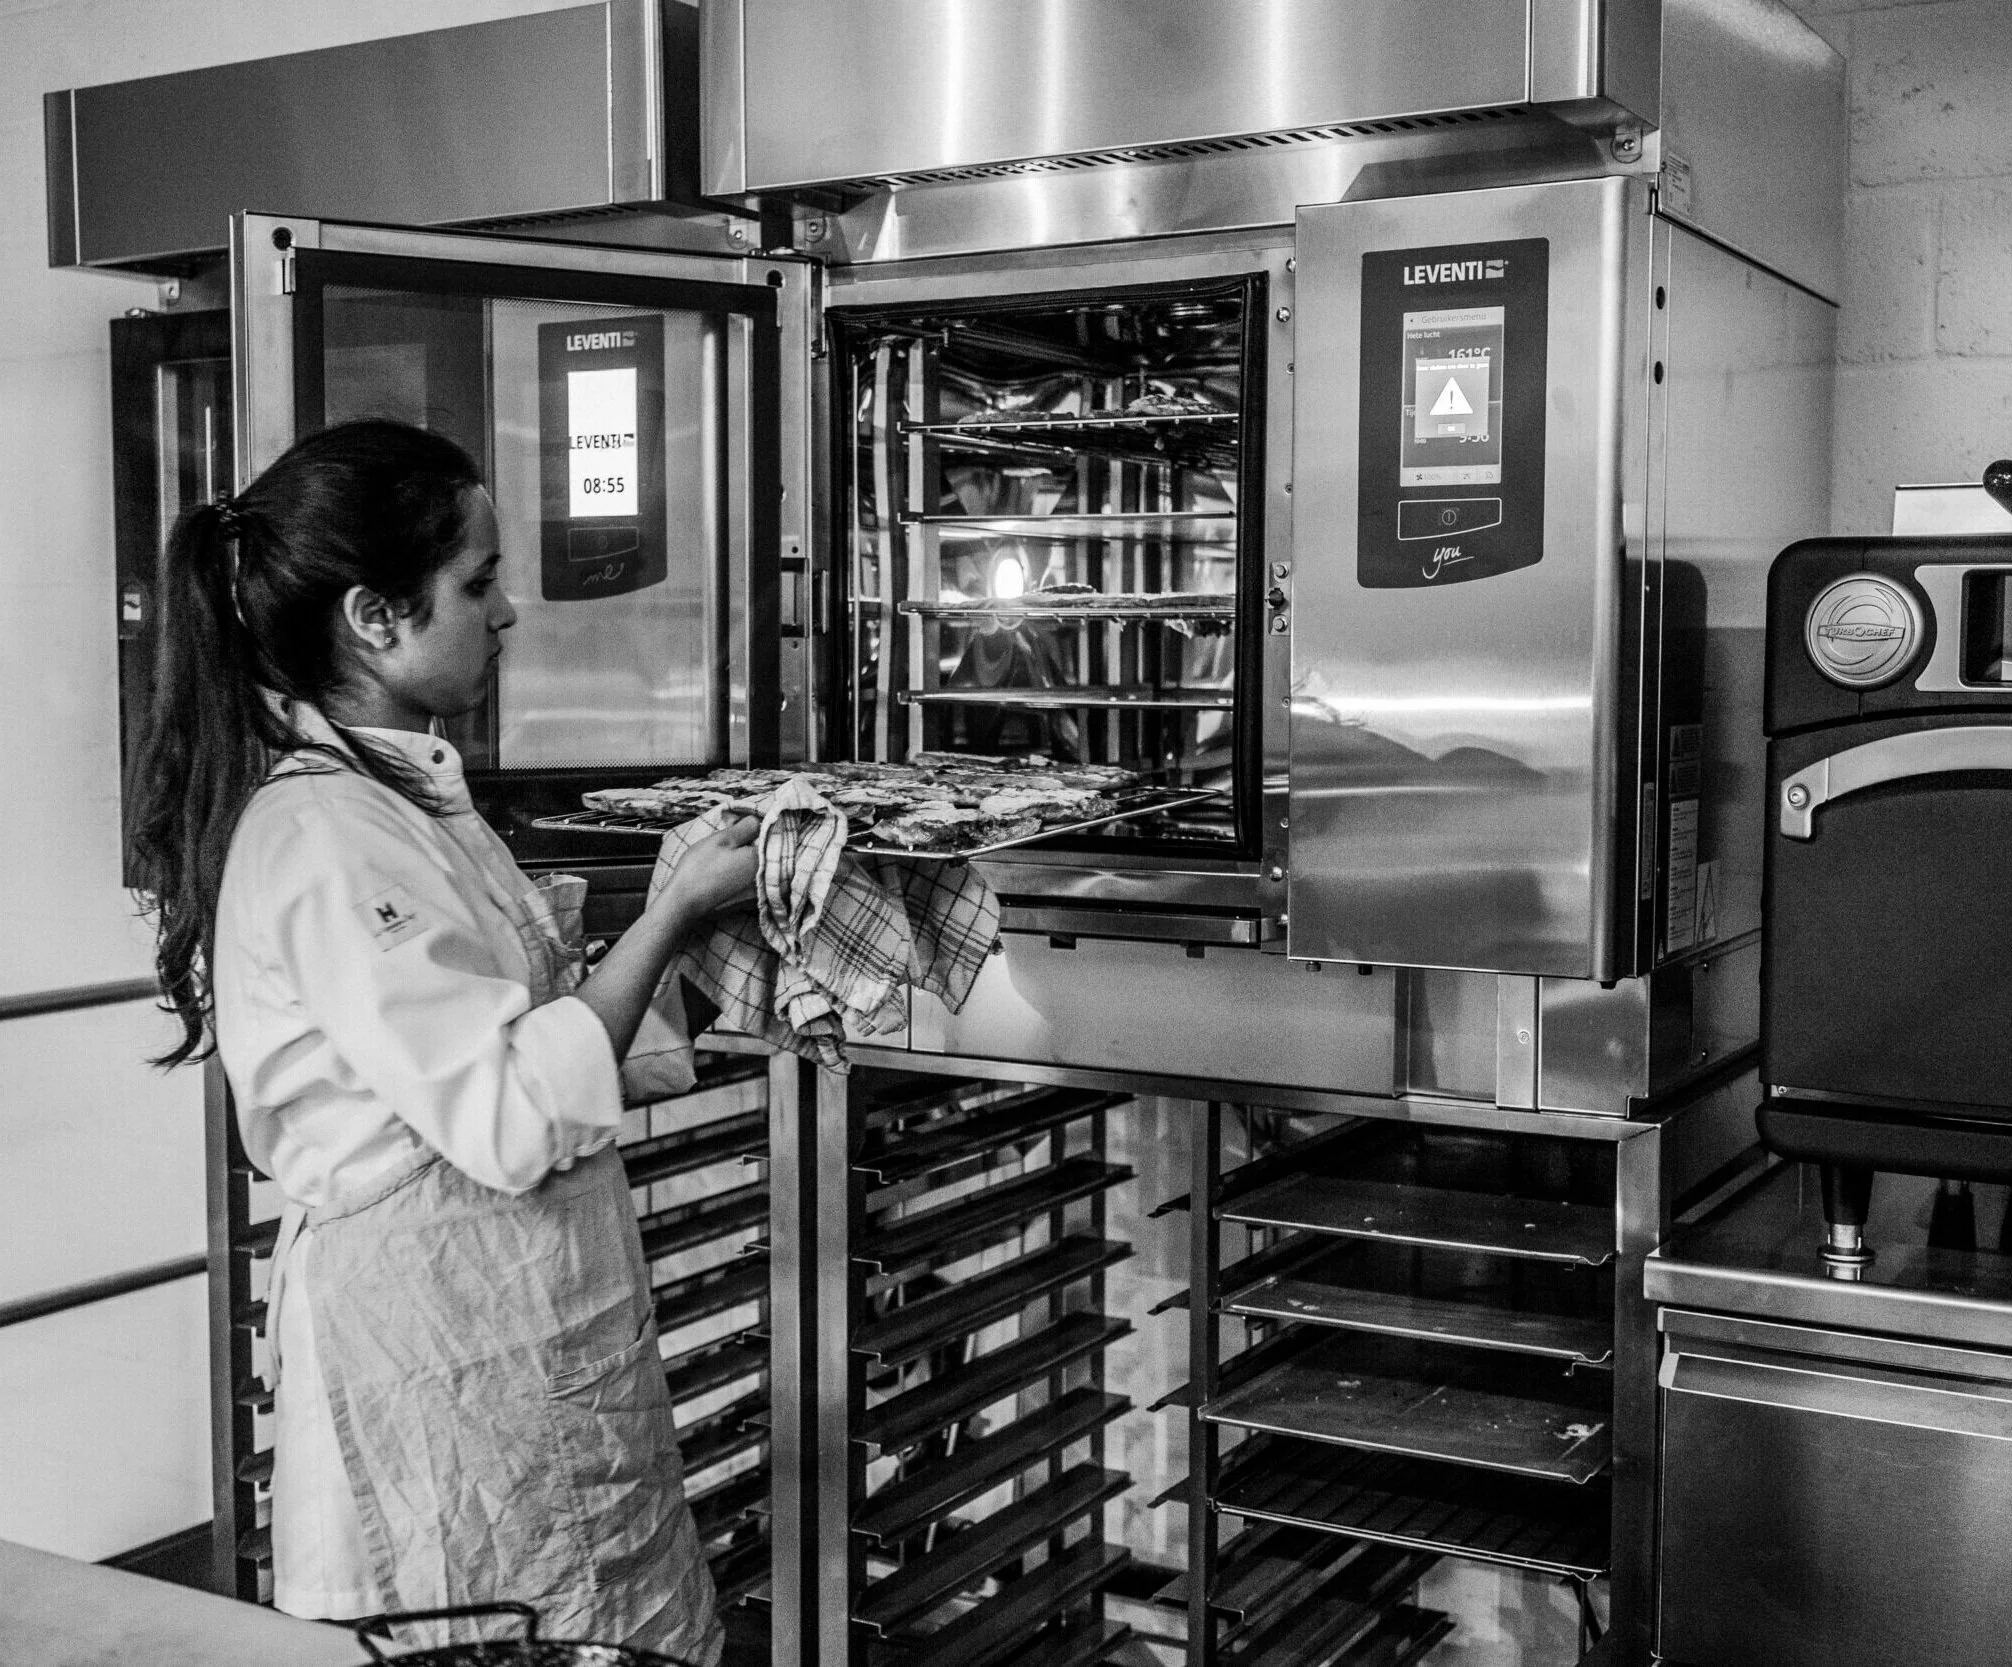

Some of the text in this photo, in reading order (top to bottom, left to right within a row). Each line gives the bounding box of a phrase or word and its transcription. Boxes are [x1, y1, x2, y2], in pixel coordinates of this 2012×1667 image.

[1404, 261, 1483, 286] LEVENTI
[567, 332, 621, 351] LEVENTI
[583, 477, 625, 494] 08:55
